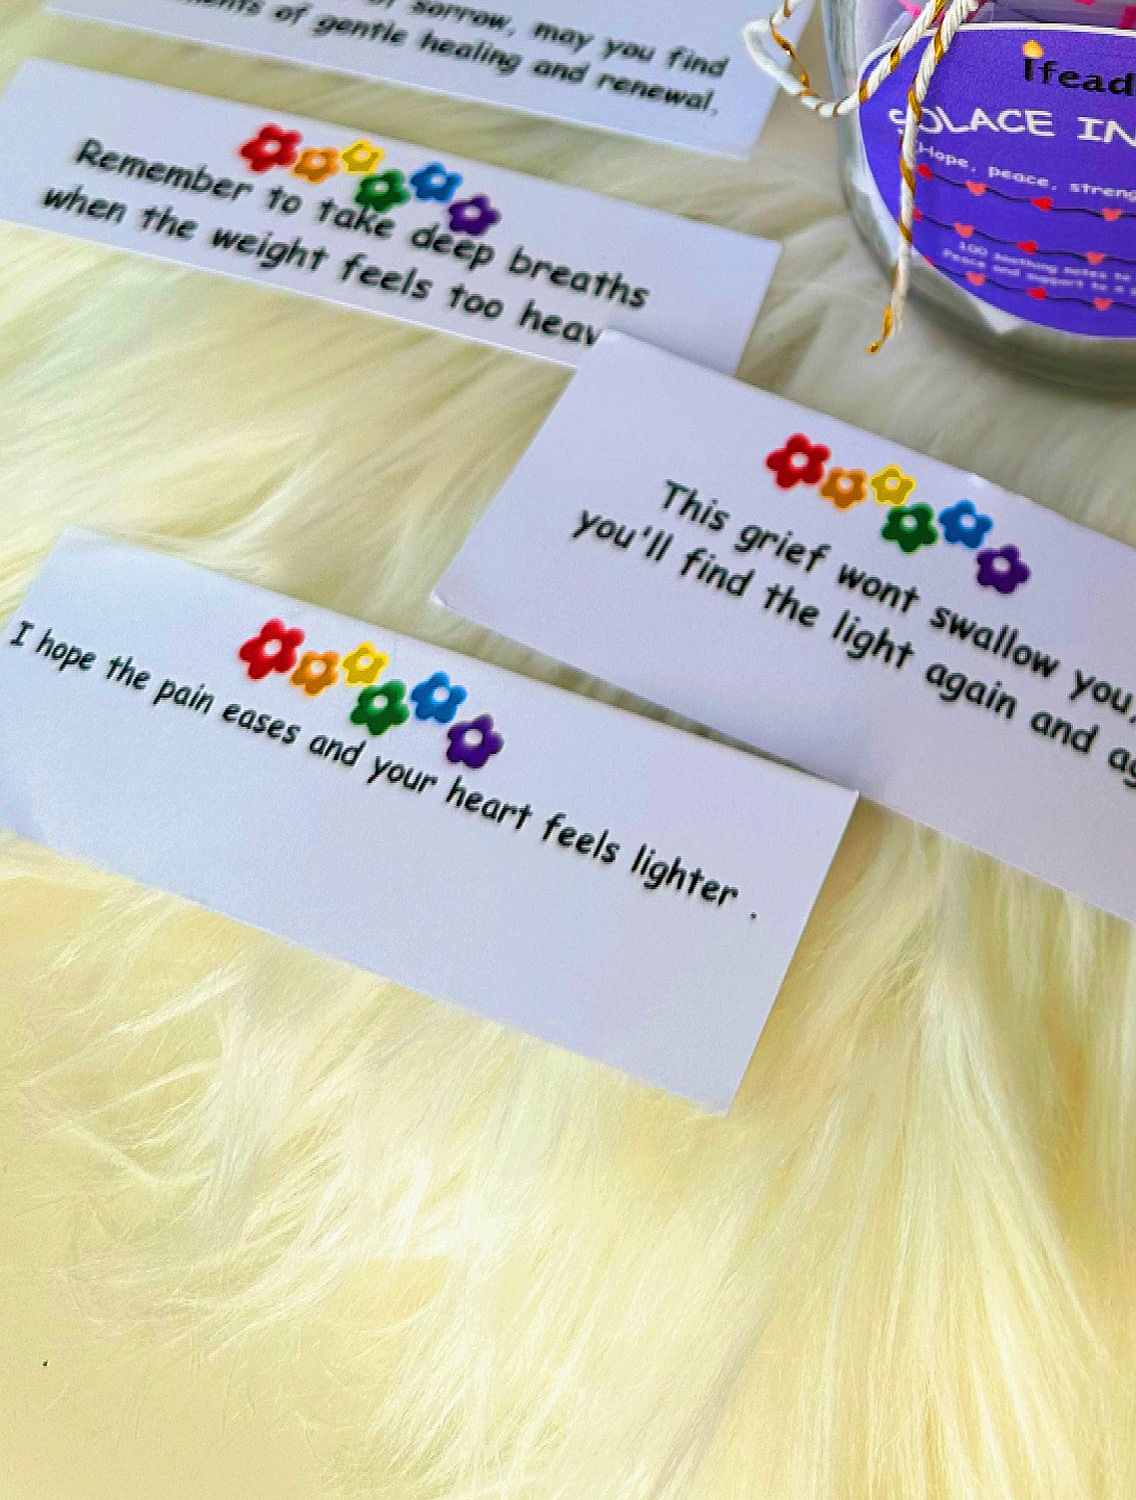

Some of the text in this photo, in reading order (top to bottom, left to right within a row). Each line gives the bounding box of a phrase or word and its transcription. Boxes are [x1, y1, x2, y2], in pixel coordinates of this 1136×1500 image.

[274, 3, 312, 24] of
[312, 15, 410, 46] gentle
[420, 30, 522, 75] healing
[531, 60, 590, 84] and
[533, 22, 595, 53] may
[602, 37, 656, 62] you
[666, 47, 729, 78] find
[43, 185, 127, 224] when
[142, 204, 199, 240] the
[212, 227, 329, 271] weight
[342, 252, 434, 299] feels
[450, 283, 504, 319] too
[76, 138, 649, 308] Remember to take deep breaths
[988, 167, 1057, 191] peace,
[573, 510, 674, 562] you'll
[681, 548, 756, 597] find
[764, 583, 820, 628] the
[833, 610, 914, 669] light
[925, 662, 1017, 719] again
[1030, 711, 1099, 754] and
[663, 479, 730, 532] This
[734, 523, 832, 572] grief
[837, 563, 920, 613] wont
[930, 606, 1061, 678] swallow
[10, 620, 35, 647] I
[35, 627, 98, 672] hope
[106, 656, 151, 691] the
[152, 679, 215, 715] pain
[222, 702, 302, 745] eases
[309, 734, 366, 767] and
[367, 755, 438, 794] your
[446, 775, 533, 830] heart
[543, 812, 620, 864] feels
